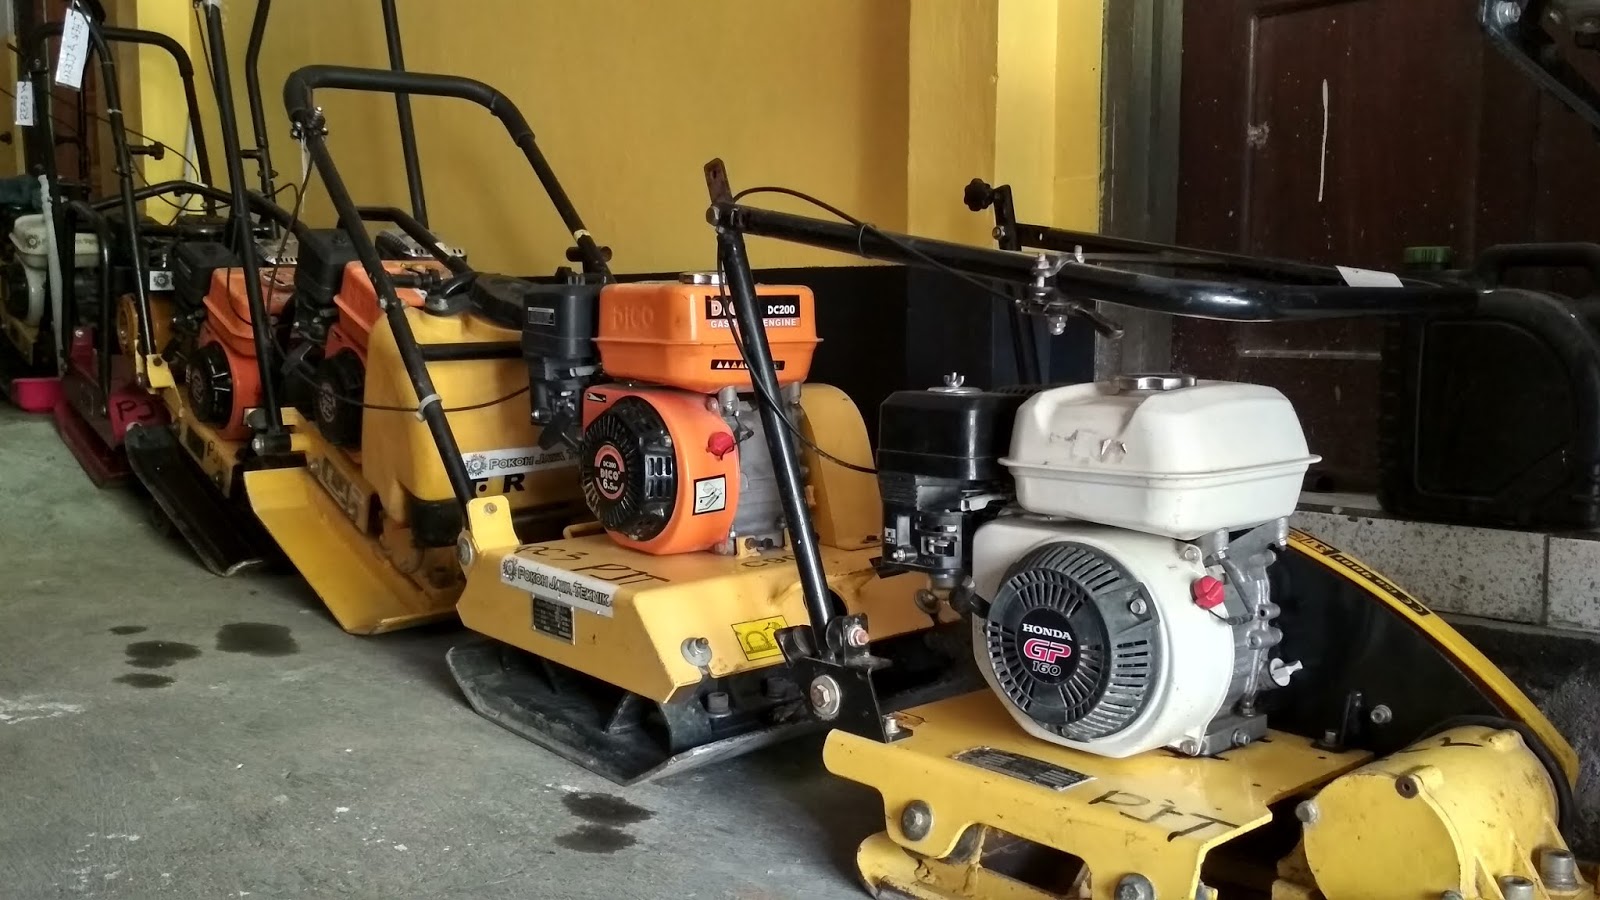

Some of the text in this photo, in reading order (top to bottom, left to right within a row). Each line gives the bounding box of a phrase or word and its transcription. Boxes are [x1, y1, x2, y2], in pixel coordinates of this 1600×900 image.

[767, 305, 796, 315] DC200
[763, 318, 797, 327] ENGINE
[489, 456, 535, 470] POKOH
[602, 460, 617, 469] DC200
[600, 468, 620, 481] DICO
[517, 566, 613, 607] POKOH JAWA TEKNIK
[1022, 623, 1073, 641] HONDA
[1023, 637, 1072, 664] GP
[1032, 660, 1061, 676] 160
